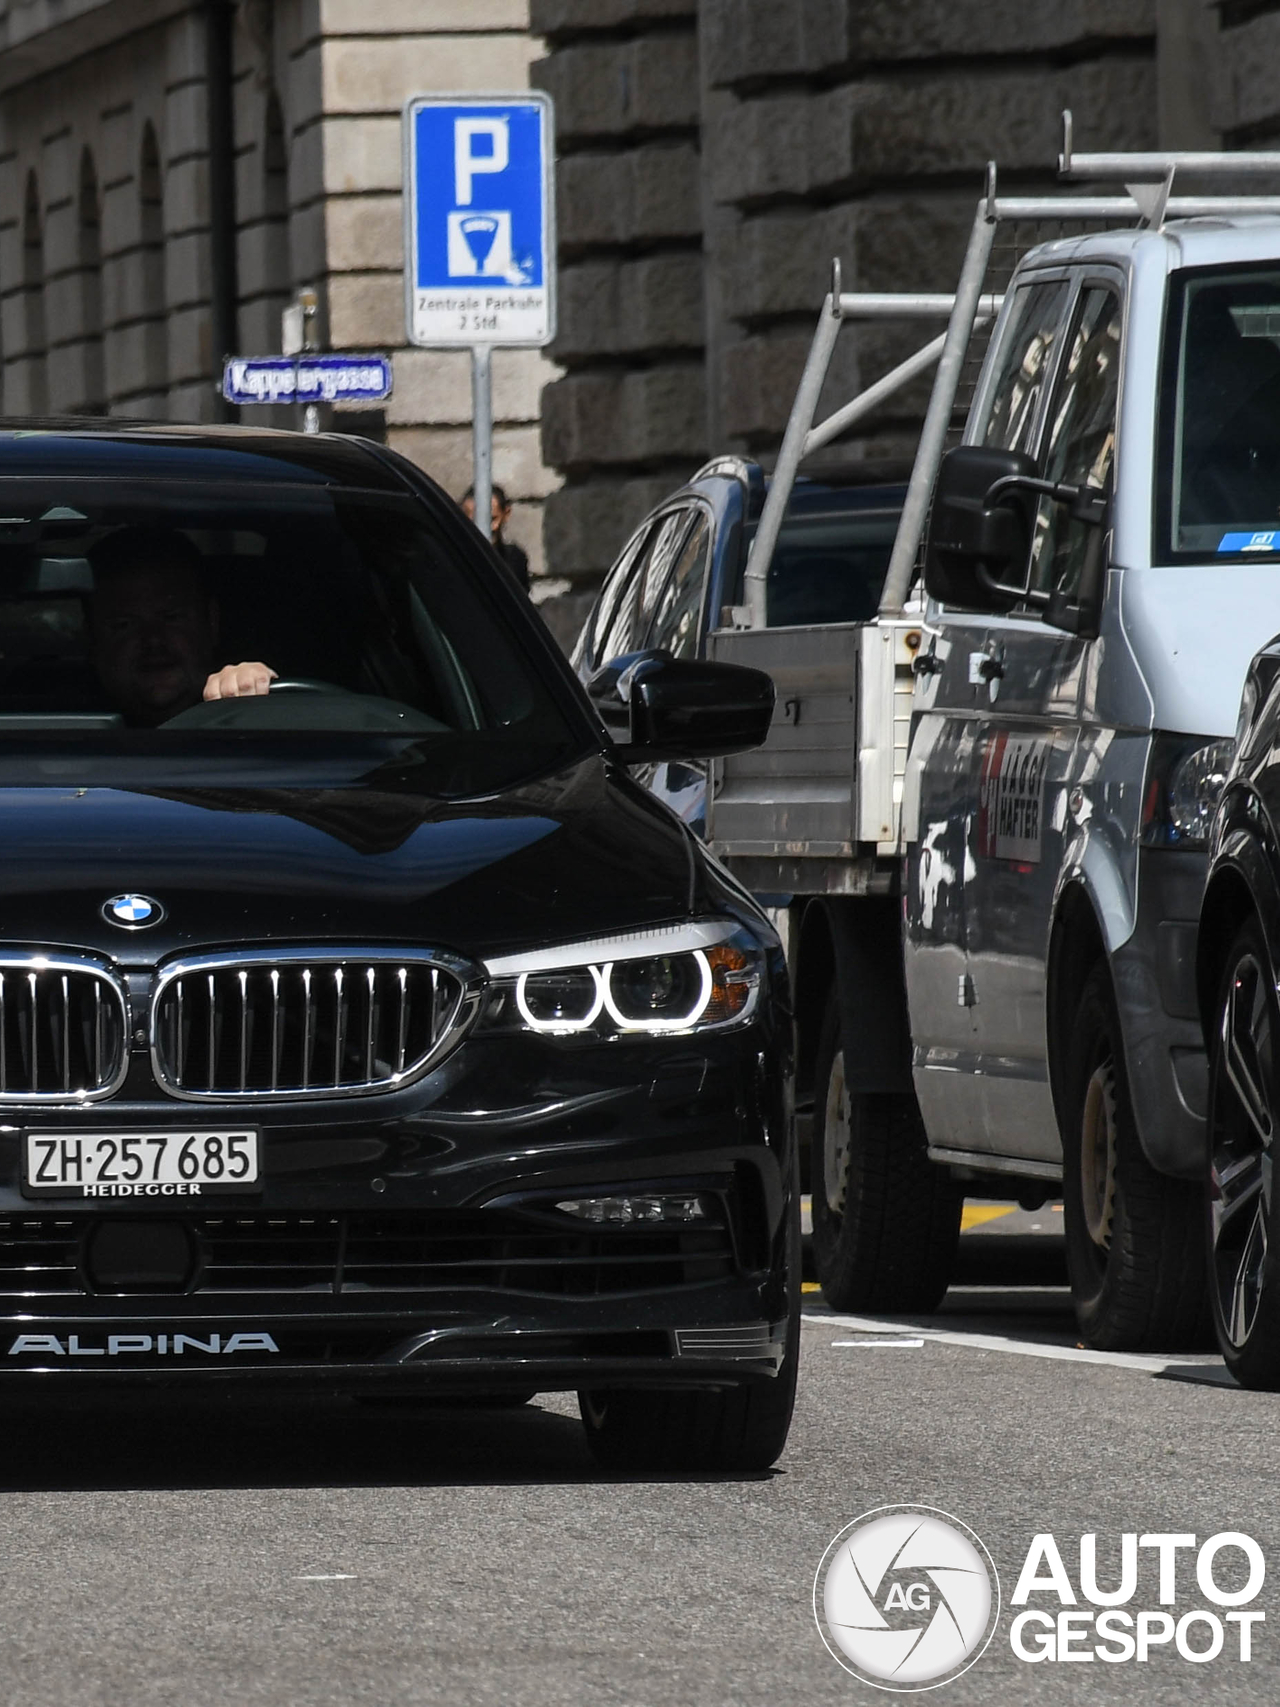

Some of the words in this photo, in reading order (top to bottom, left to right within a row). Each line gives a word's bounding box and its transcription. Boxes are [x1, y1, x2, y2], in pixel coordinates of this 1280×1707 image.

[454, 115, 510, 206] P
[419, 296, 479, 311] Zentrale
[485, 295, 543, 311] Parkuhr
[231, 363, 385, 401] Kappeergasse
[999, 797, 1039, 840] HAFTER
[83, 1182, 202, 1198] HEIDEGGER
[8, 1332, 280, 1356] ALPINA
